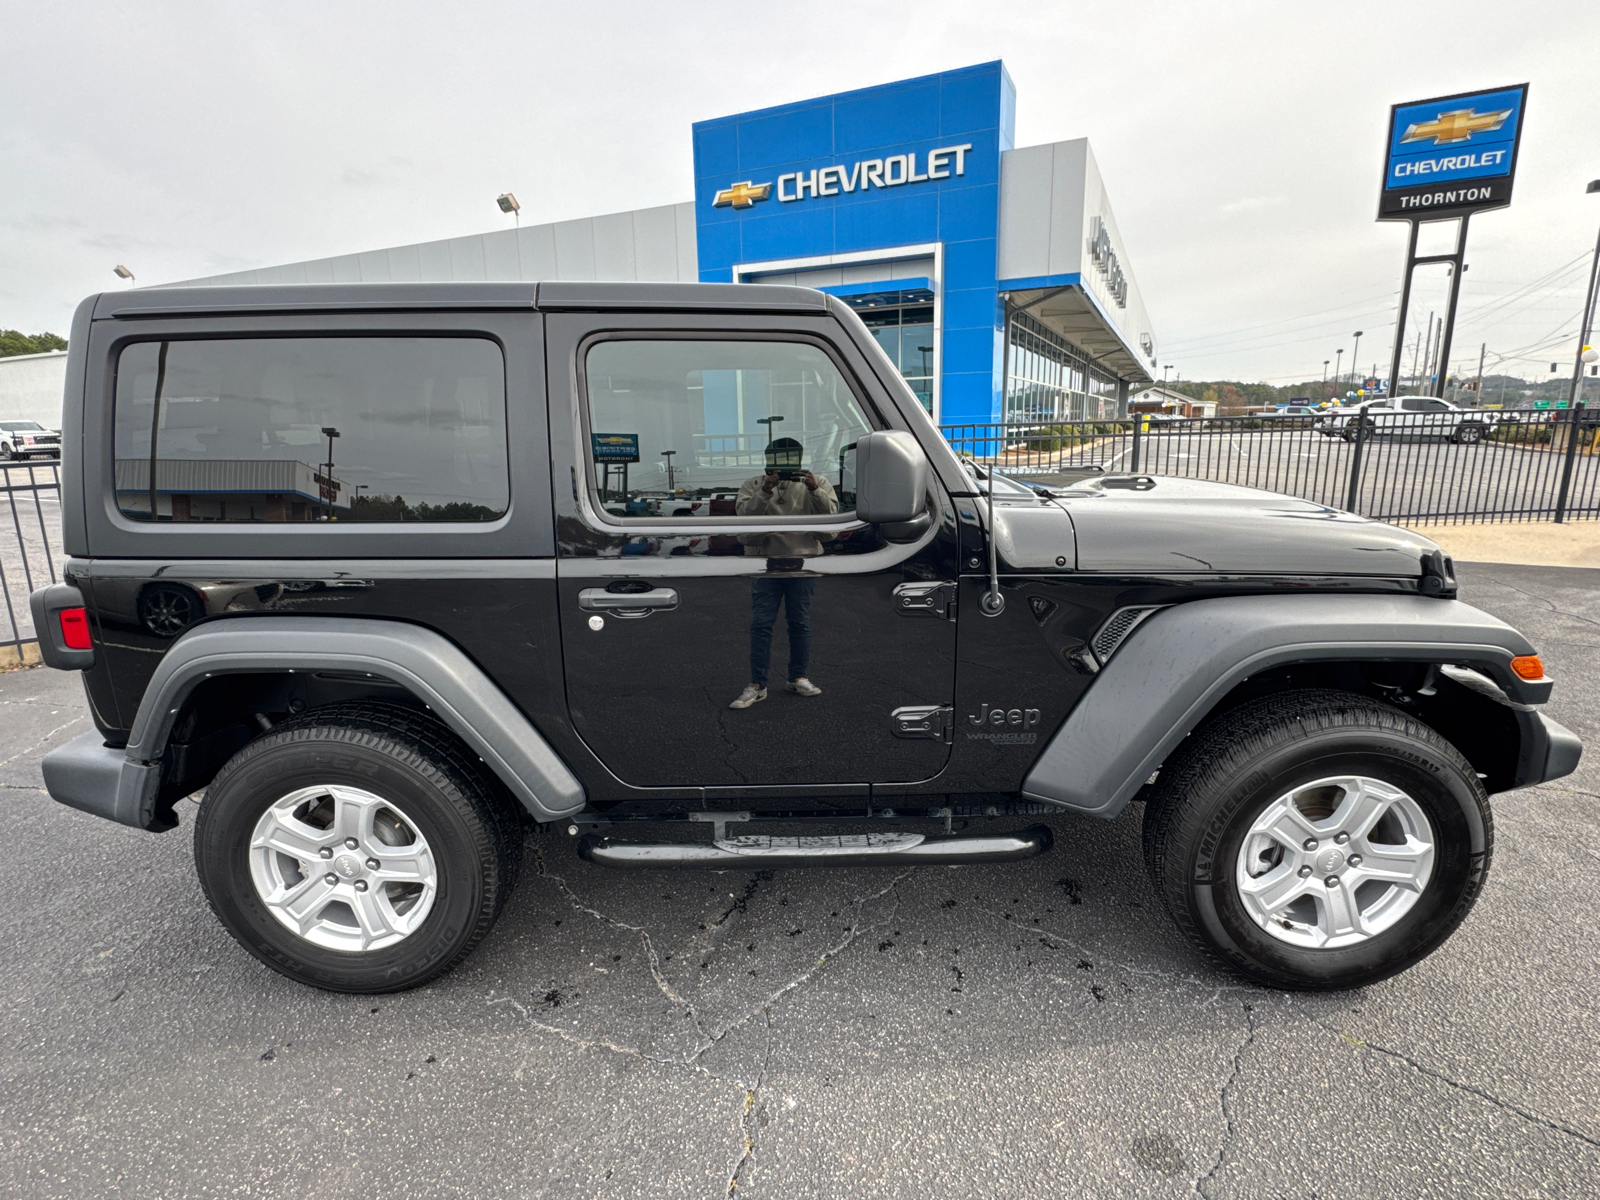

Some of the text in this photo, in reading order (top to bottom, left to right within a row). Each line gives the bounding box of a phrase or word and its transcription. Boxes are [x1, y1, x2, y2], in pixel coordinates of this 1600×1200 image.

[777, 143, 972, 203] CHEVROLET
[1394, 150, 1506, 177] CHEVROLET
[1400, 187, 1492, 208] THORNTON
[969, 703, 1041, 730] Jeep
[966, 732, 1038, 740] WRANGLER
[246, 752, 380, 790] COOPER
[1200, 770, 1267, 859] MICHELIN
